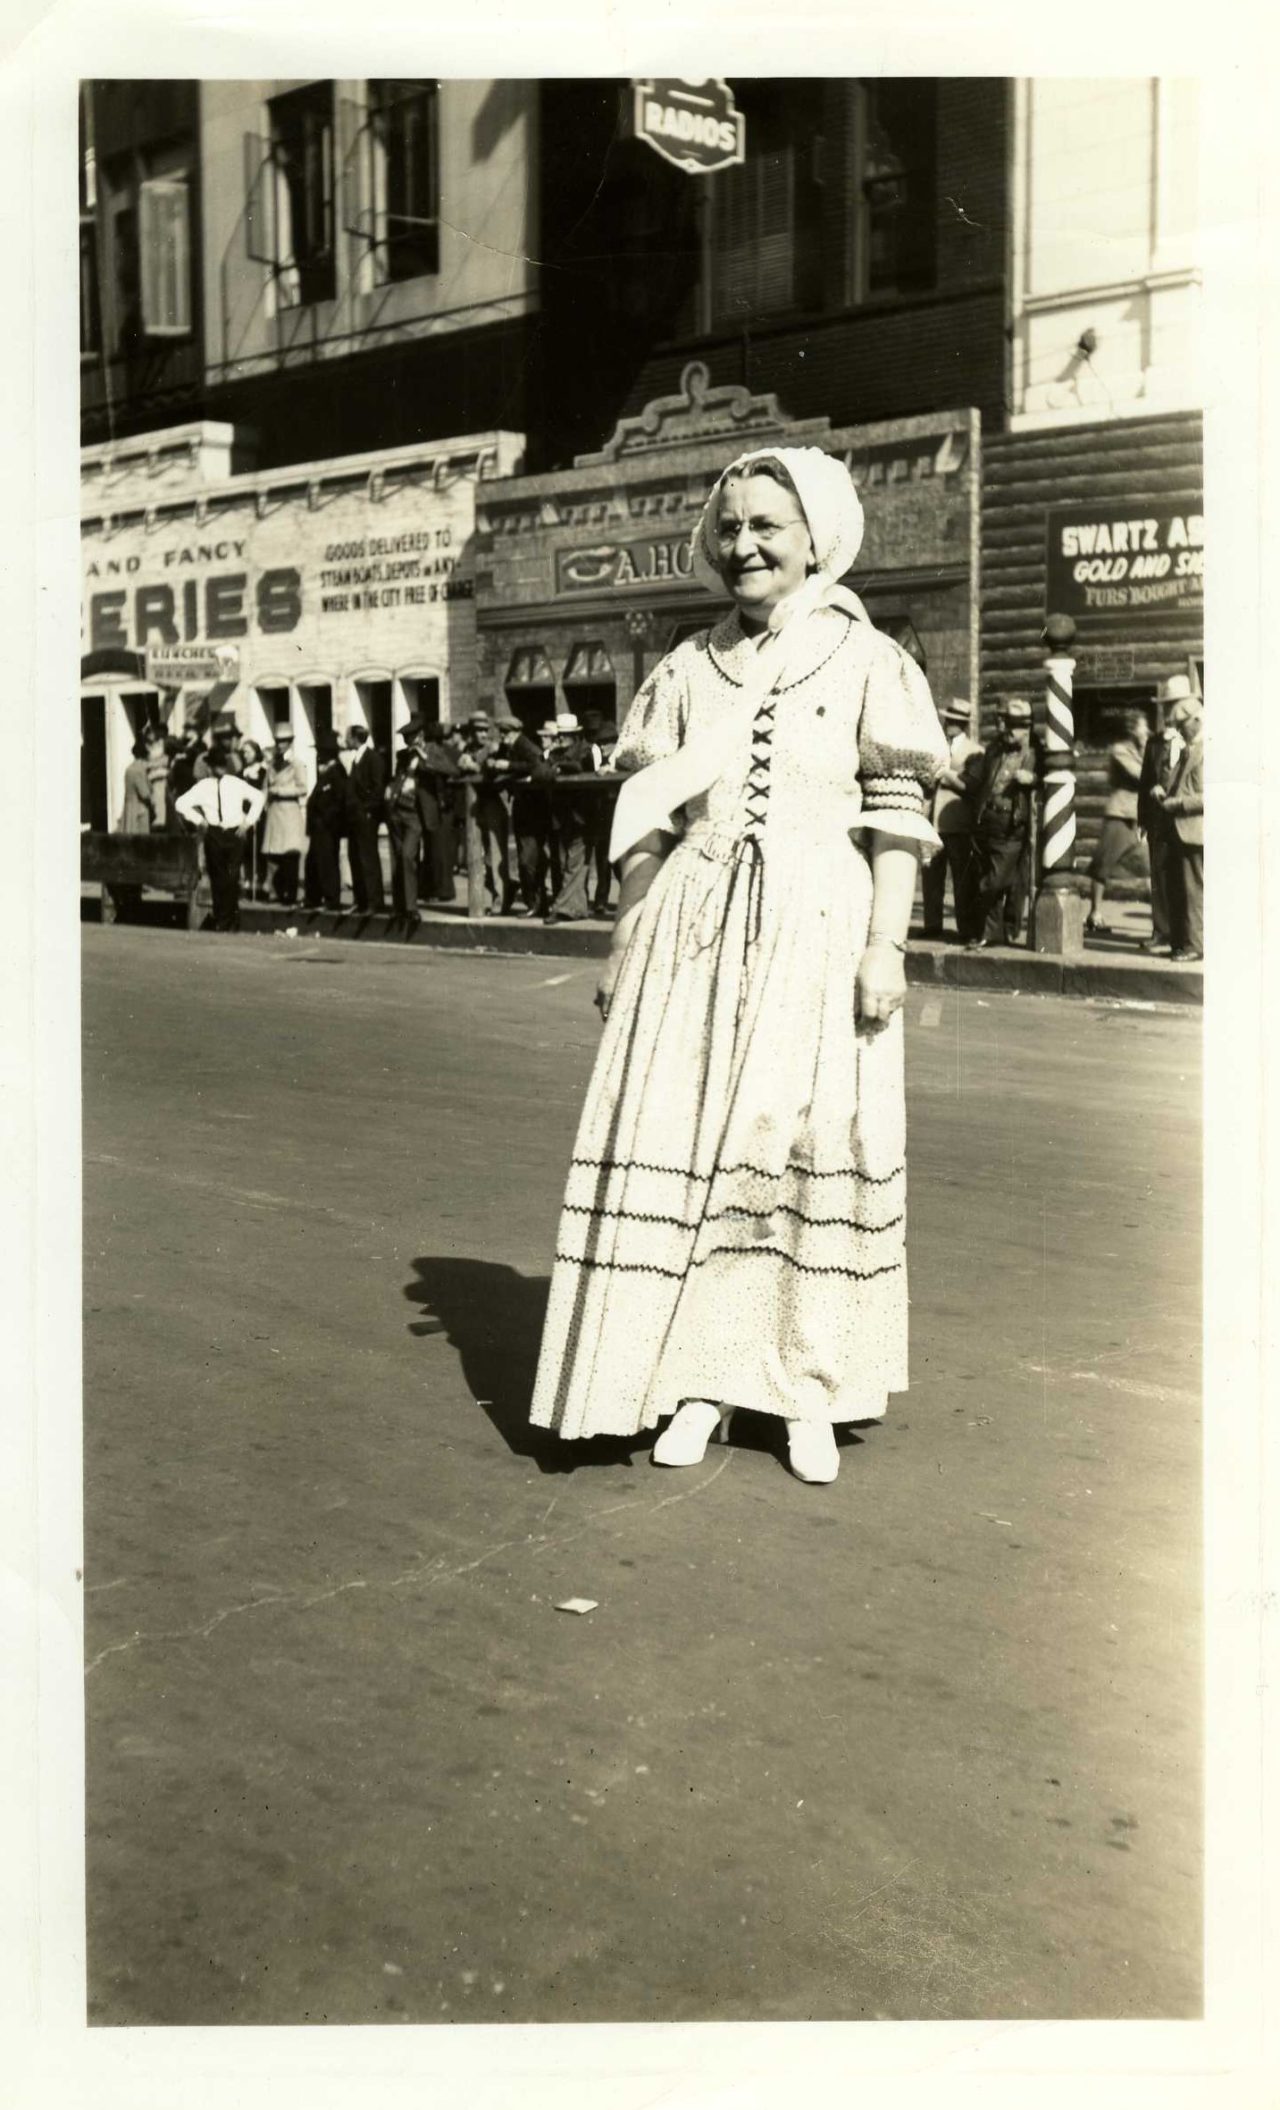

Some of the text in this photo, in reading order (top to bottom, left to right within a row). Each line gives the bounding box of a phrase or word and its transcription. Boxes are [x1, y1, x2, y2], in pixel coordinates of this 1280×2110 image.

[645, 101, 736, 151] RADIOS
[325, 529, 451, 562] GOODS DELIVERED TO
[1062, 519, 1159, 557] SWARTZ
[87, 540, 246, 577] AND FANCY
[1073, 556, 1129, 583] GOLD
[1129, 553, 1171, 579] AND
[80, 566, 302, 650] ERIES
[322, 593, 349, 613] WHERE
[352, 592, 361, 610] IN
[381, 587, 400, 608] CITY
[404, 585, 425, 605] FREE
[429, 583, 438, 602] OF
[1085, 586, 1128, 607] FURS
[1128, 578, 1187, 606] BOUGHT
